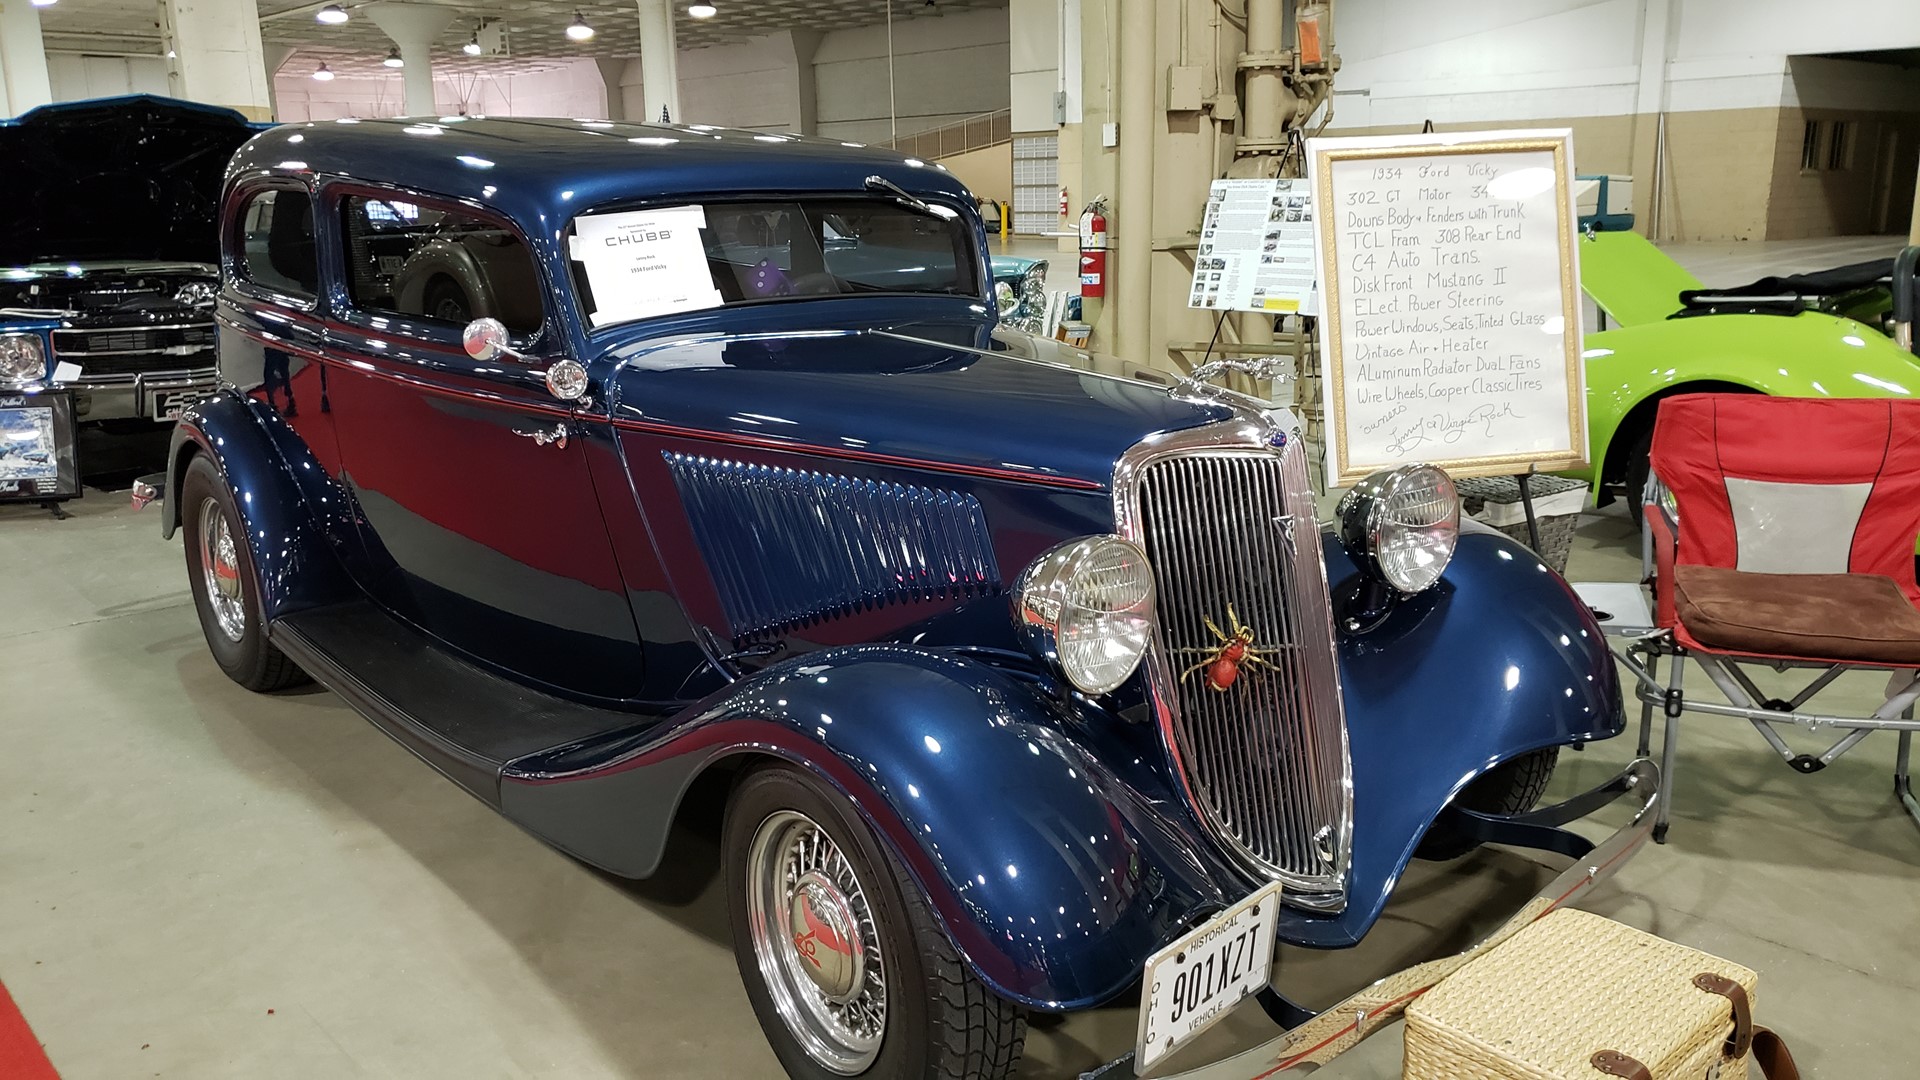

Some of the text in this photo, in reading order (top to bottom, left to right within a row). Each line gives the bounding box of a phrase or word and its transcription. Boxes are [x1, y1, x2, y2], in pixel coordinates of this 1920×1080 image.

[1372, 162, 1499, 181] 1934 Ford Vicky
[1347, 190, 1380, 206] 302
[1419, 188, 1452, 201] Motor
[1348, 211, 1384, 229] Downs
[1388, 207, 1415, 229] Body
[1427, 206, 1464, 223] Fenders
[1468, 207, 1487, 220] with
[605, 230, 671, 246] CHUBB
[1391, 229, 1421, 248] Fram
[1435, 229, 1461, 244] 308
[1465, 225, 1493, 243] Rear
[1496, 223, 1522, 241] End
[1352, 247, 1481, 273] C4 Auto Trans.
[1353, 275, 1380, 294] Disk
[1384, 274, 1413, 291] Front
[1493, 266, 1508, 286] II
[1408, 295, 1441, 312] Power
[1355, 320, 1390, 338] Power
[1409, 339, 1430, 354] Air
[1442, 336, 1489, 351] Heater
[1423, 357, 1472, 377] Radiator
[1509, 354, 1541, 371] Fans
[1357, 386, 1383, 404] Wire
[1428, 384, 1470, 402] Cooper
[1509, 372, 1543, 391] Tires
[1190, 916, 1239, 954] HISTORICAL
[1171, 922, 1261, 1023] 901XZT
[1146, 982, 1161, 1045] OHIO
[1188, 1000, 1223, 1031] VEHICLE
